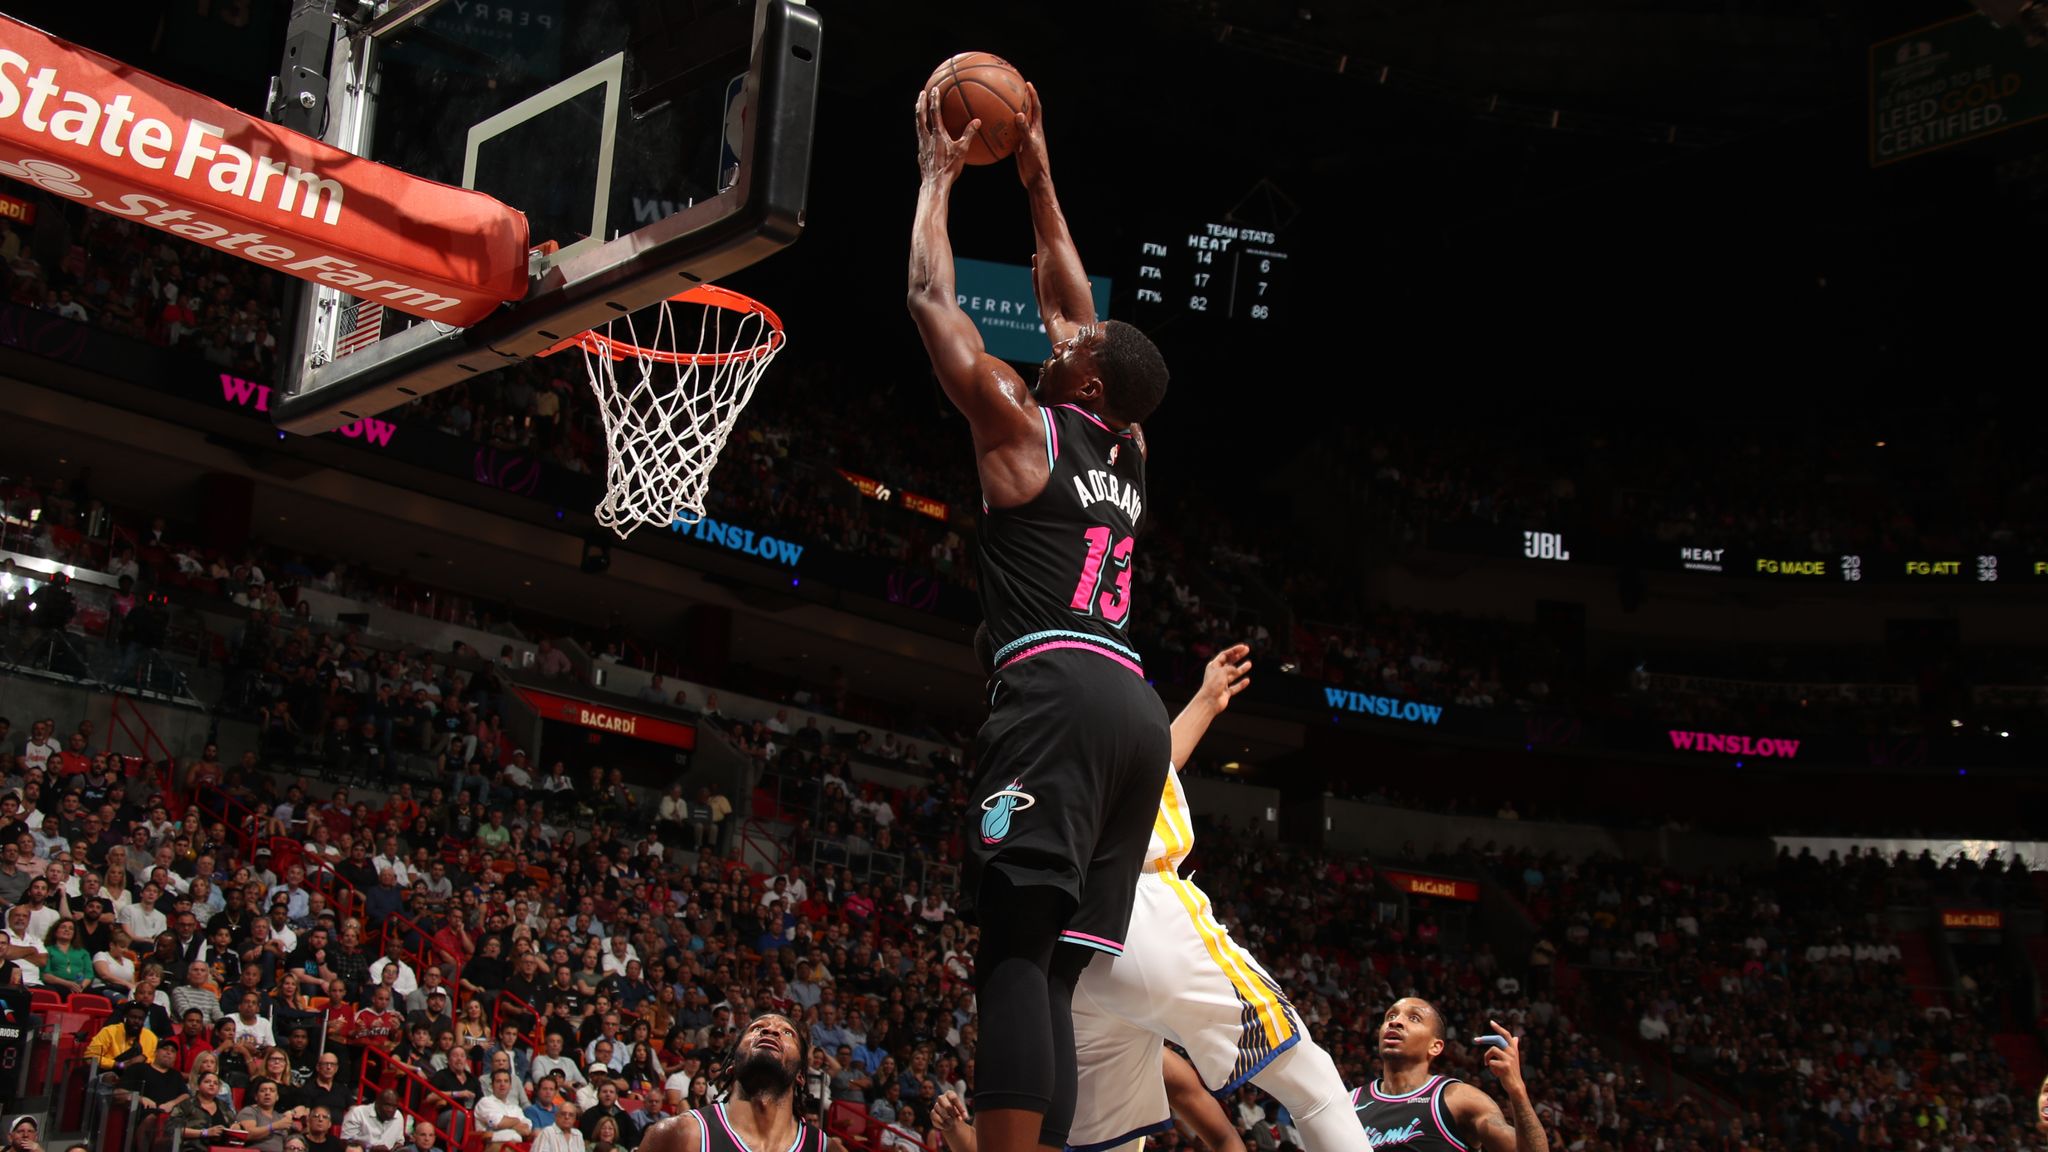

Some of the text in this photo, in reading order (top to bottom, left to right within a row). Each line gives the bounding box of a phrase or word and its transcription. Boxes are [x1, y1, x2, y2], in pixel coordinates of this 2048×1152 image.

[1879, 72, 2022, 134] LEED GOLD
[1187, 234, 1232, 253] HEAT
[1206, 222, 1276, 245] TEAM STATS
[1141, 242, 1271, 274] FTM 14 6
[1139, 265, 1268, 297] FTA 17 7
[957, 294, 1026, 316] PERRY
[1188, 295, 1208, 312] 82
[1250, 304, 1269, 320] 86
[1523, 530, 1570, 561] JBL
[1681, 547, 1725, 562] HEAT
[1069, 526, 1135, 630] 13
[1756, 555, 1860, 576] FG MADE 20
[1906, 561, 1931, 575] FG
[1932, 561, 1961, 575] ATT
[1323, 687, 1443, 726] WINSLOW
[1668, 730, 1800, 759] WINSLOW
